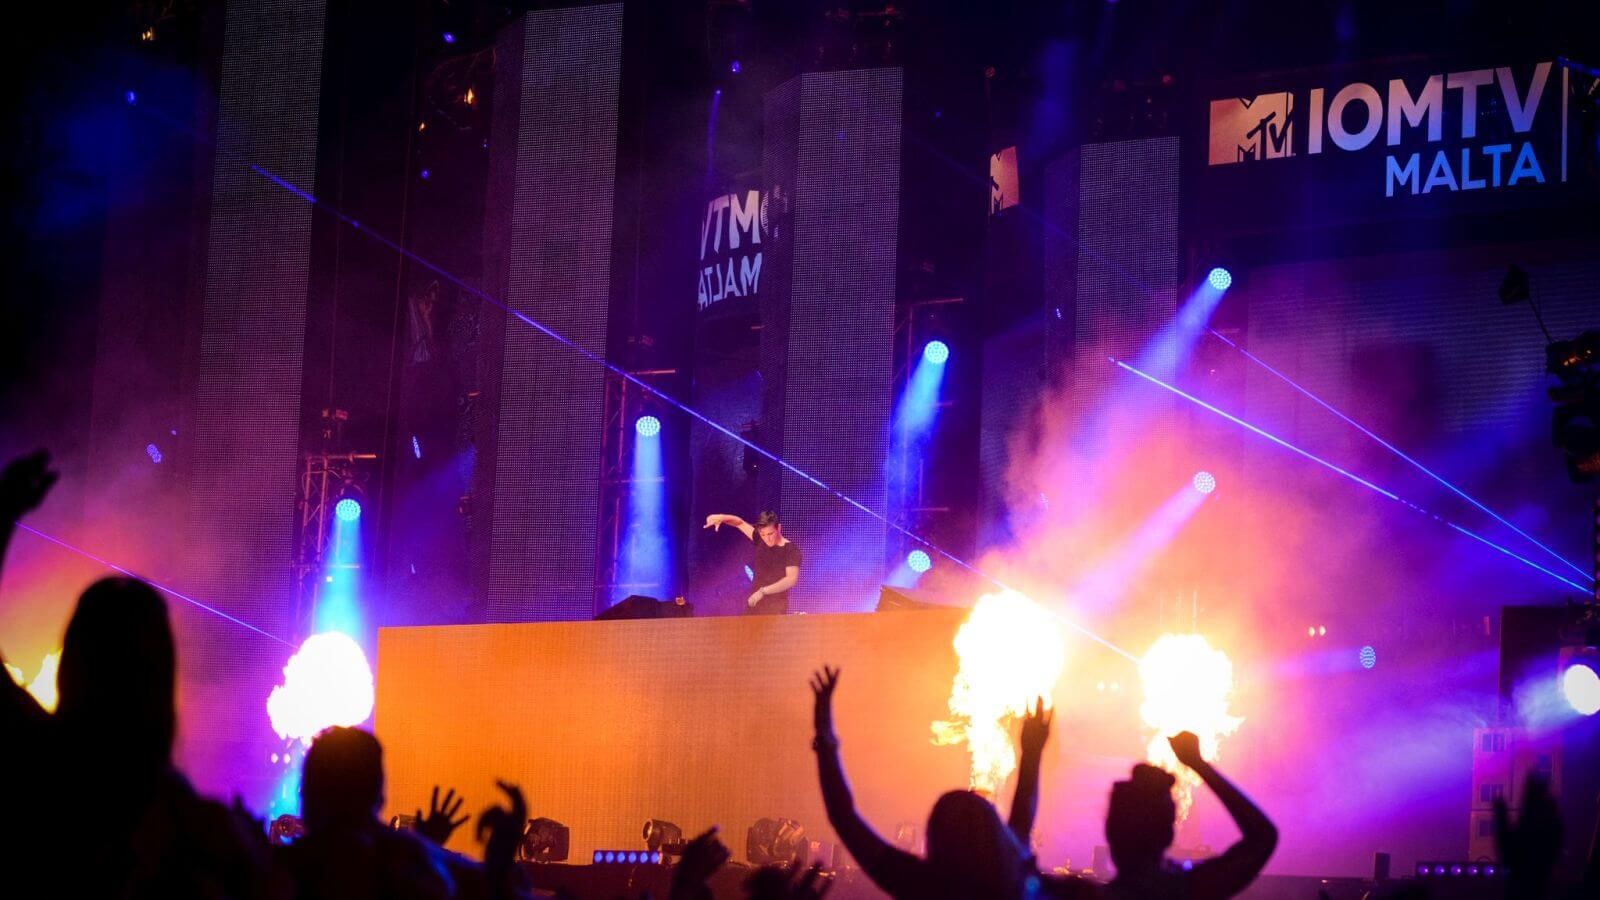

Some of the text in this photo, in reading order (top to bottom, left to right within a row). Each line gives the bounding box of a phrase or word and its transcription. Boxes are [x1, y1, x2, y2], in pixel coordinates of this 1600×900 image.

[1208, 62, 1552, 165] MTV IOMTV
[1385, 142, 1546, 197] MALTA
